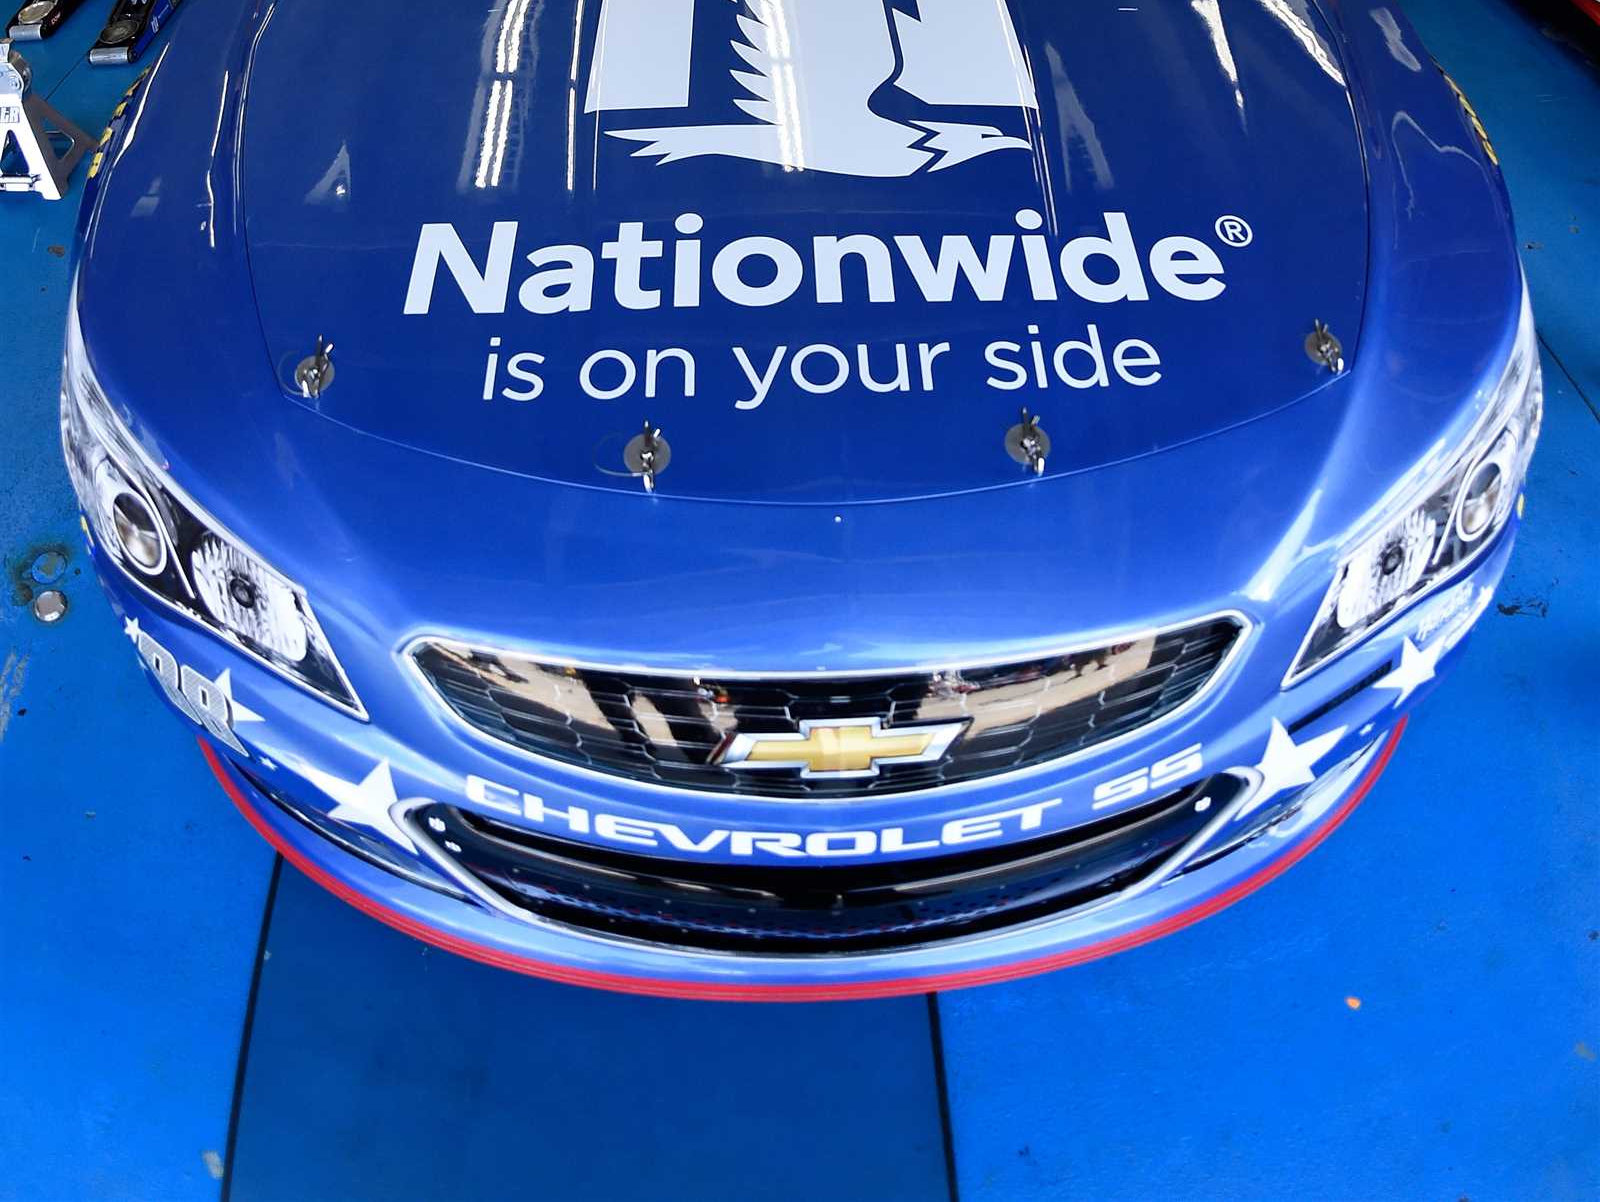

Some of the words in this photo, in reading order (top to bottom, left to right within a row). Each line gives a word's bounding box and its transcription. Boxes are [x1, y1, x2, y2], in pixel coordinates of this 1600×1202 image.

[482, 336, 545, 401] is
[579, 348, 696, 400] on
[732, 342, 950, 410] your
[984, 323, 1163, 390] side
[465, 773, 1063, 858] CHEVROLET
[1092, 743, 1204, 811] SS
